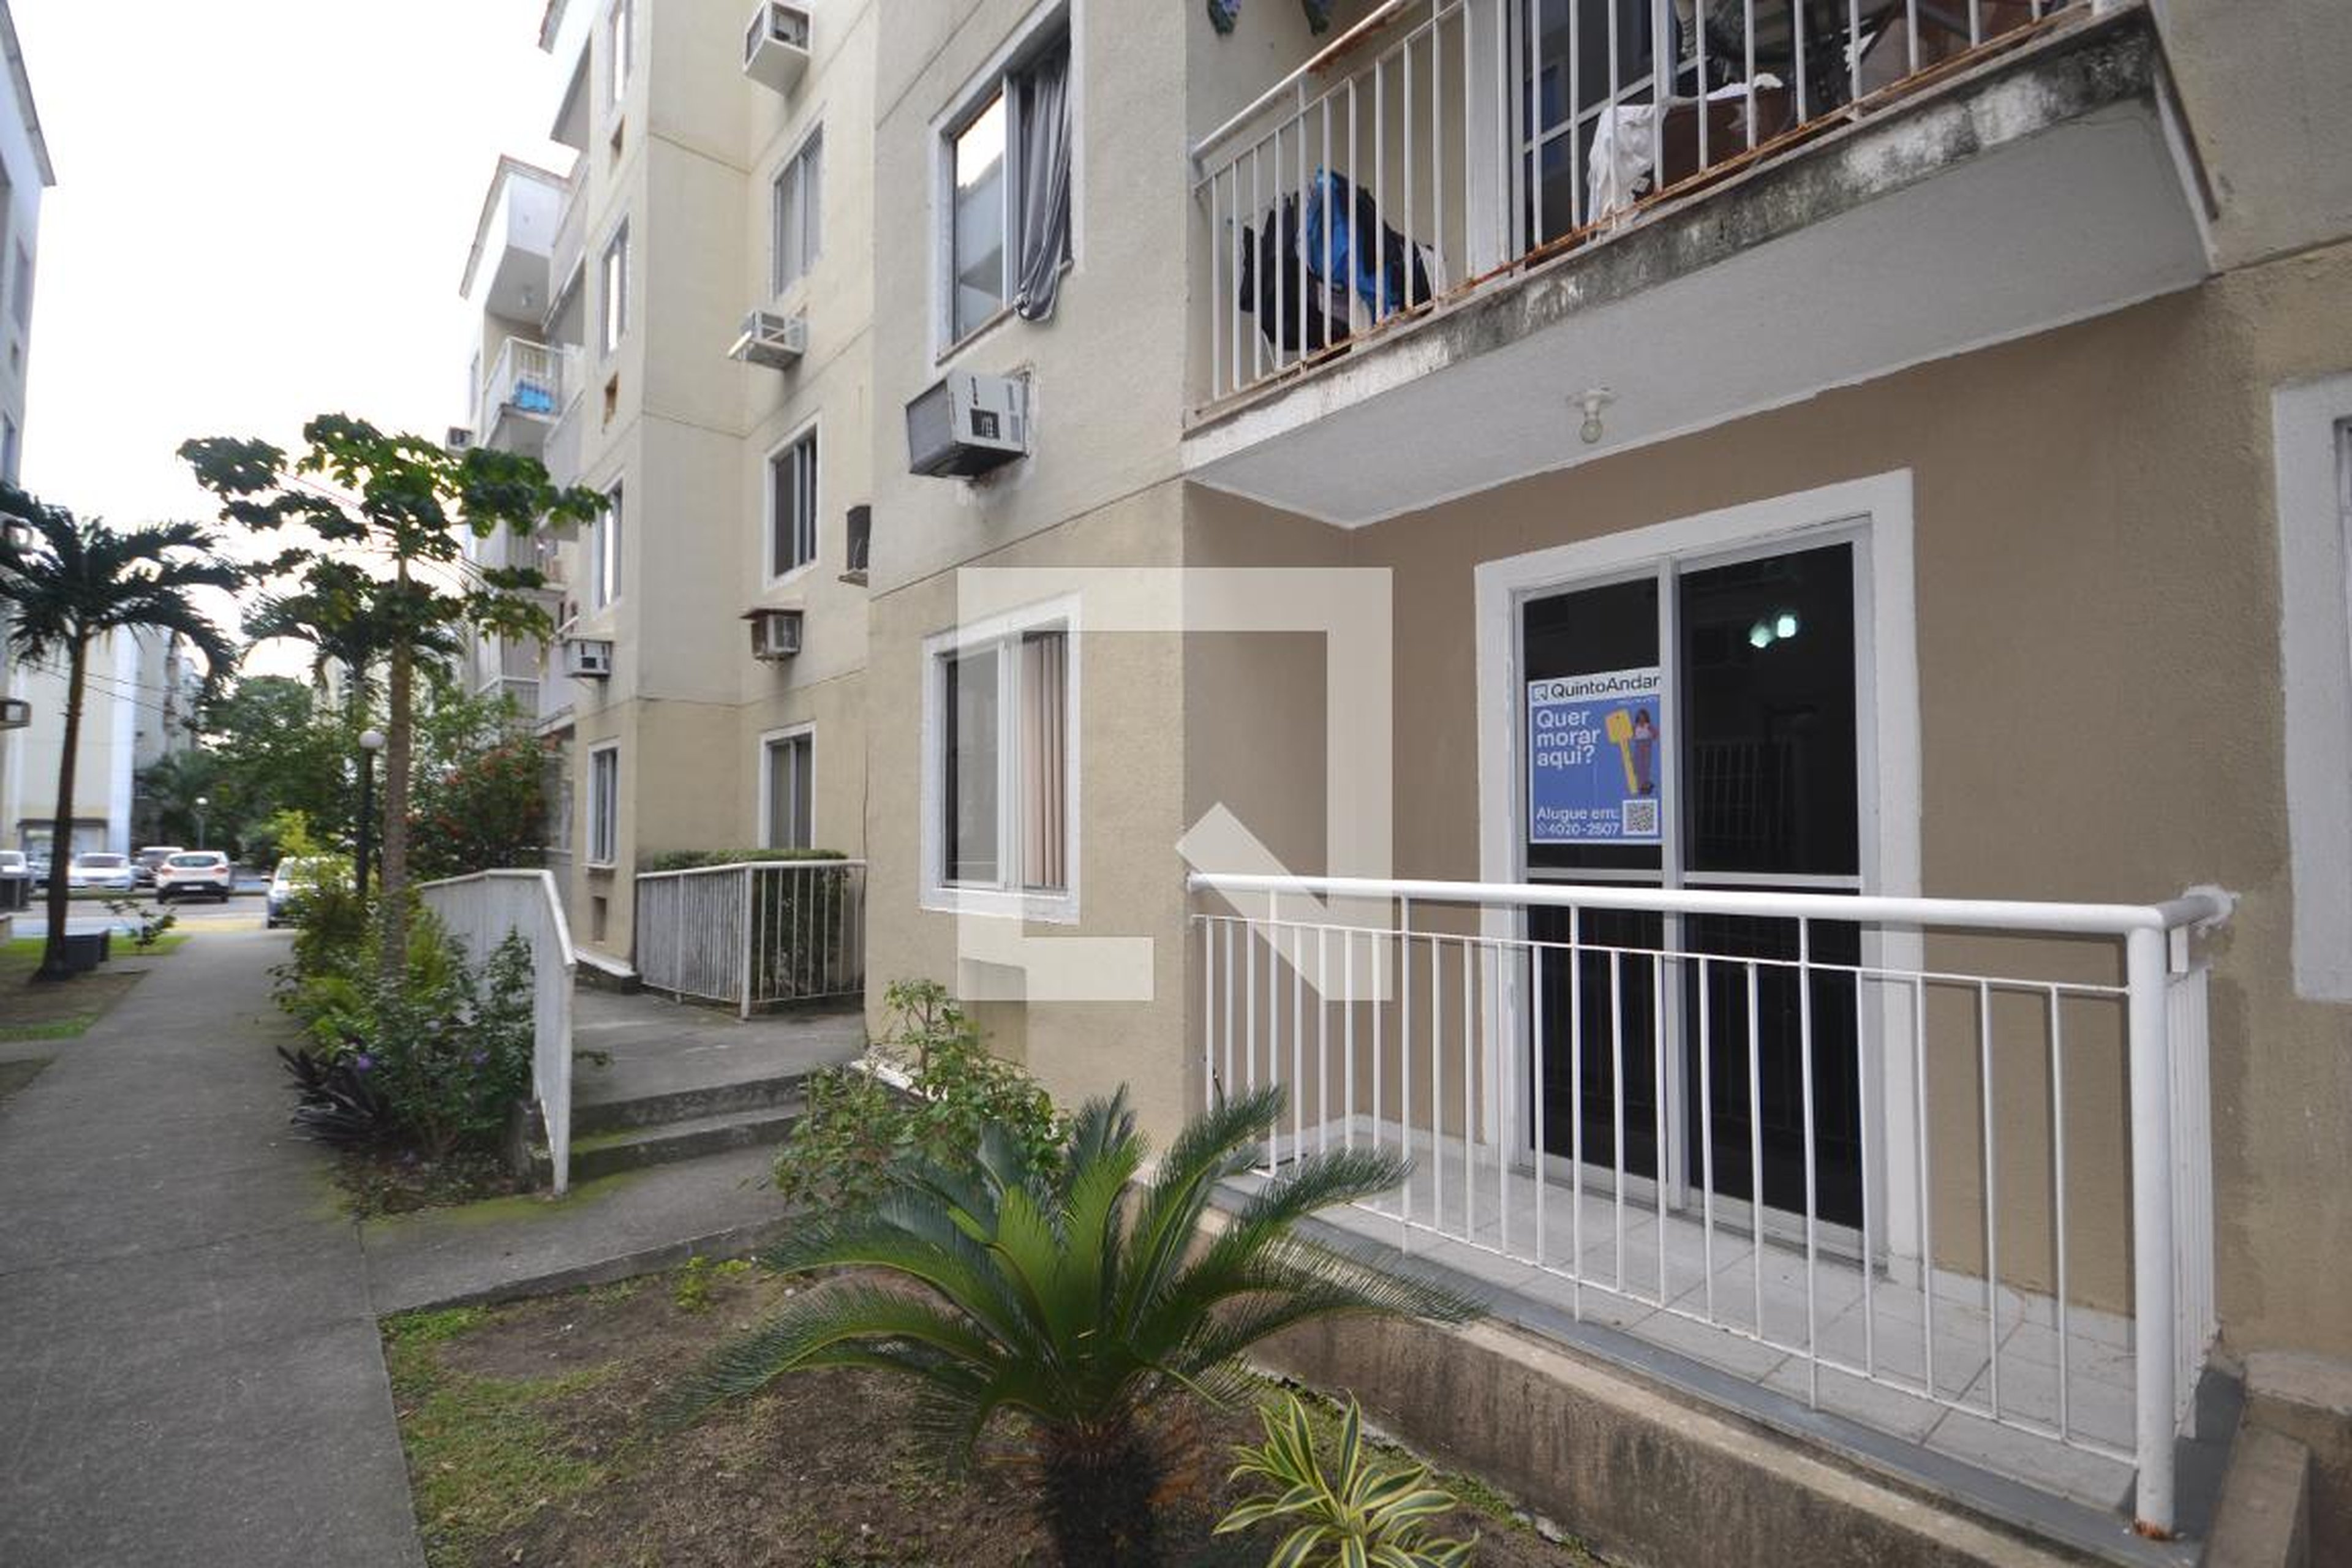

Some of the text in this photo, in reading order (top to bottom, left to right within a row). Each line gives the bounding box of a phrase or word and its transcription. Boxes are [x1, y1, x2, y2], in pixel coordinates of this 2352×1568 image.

[1551, 675, 1660, 698] QuintoAndar
[1537, 709, 1591, 728] Quer
[1537, 729, 1600, 747] morar
[1537, 745, 1595, 770] aqui?
[1536, 806, 1587, 823] Alugue
